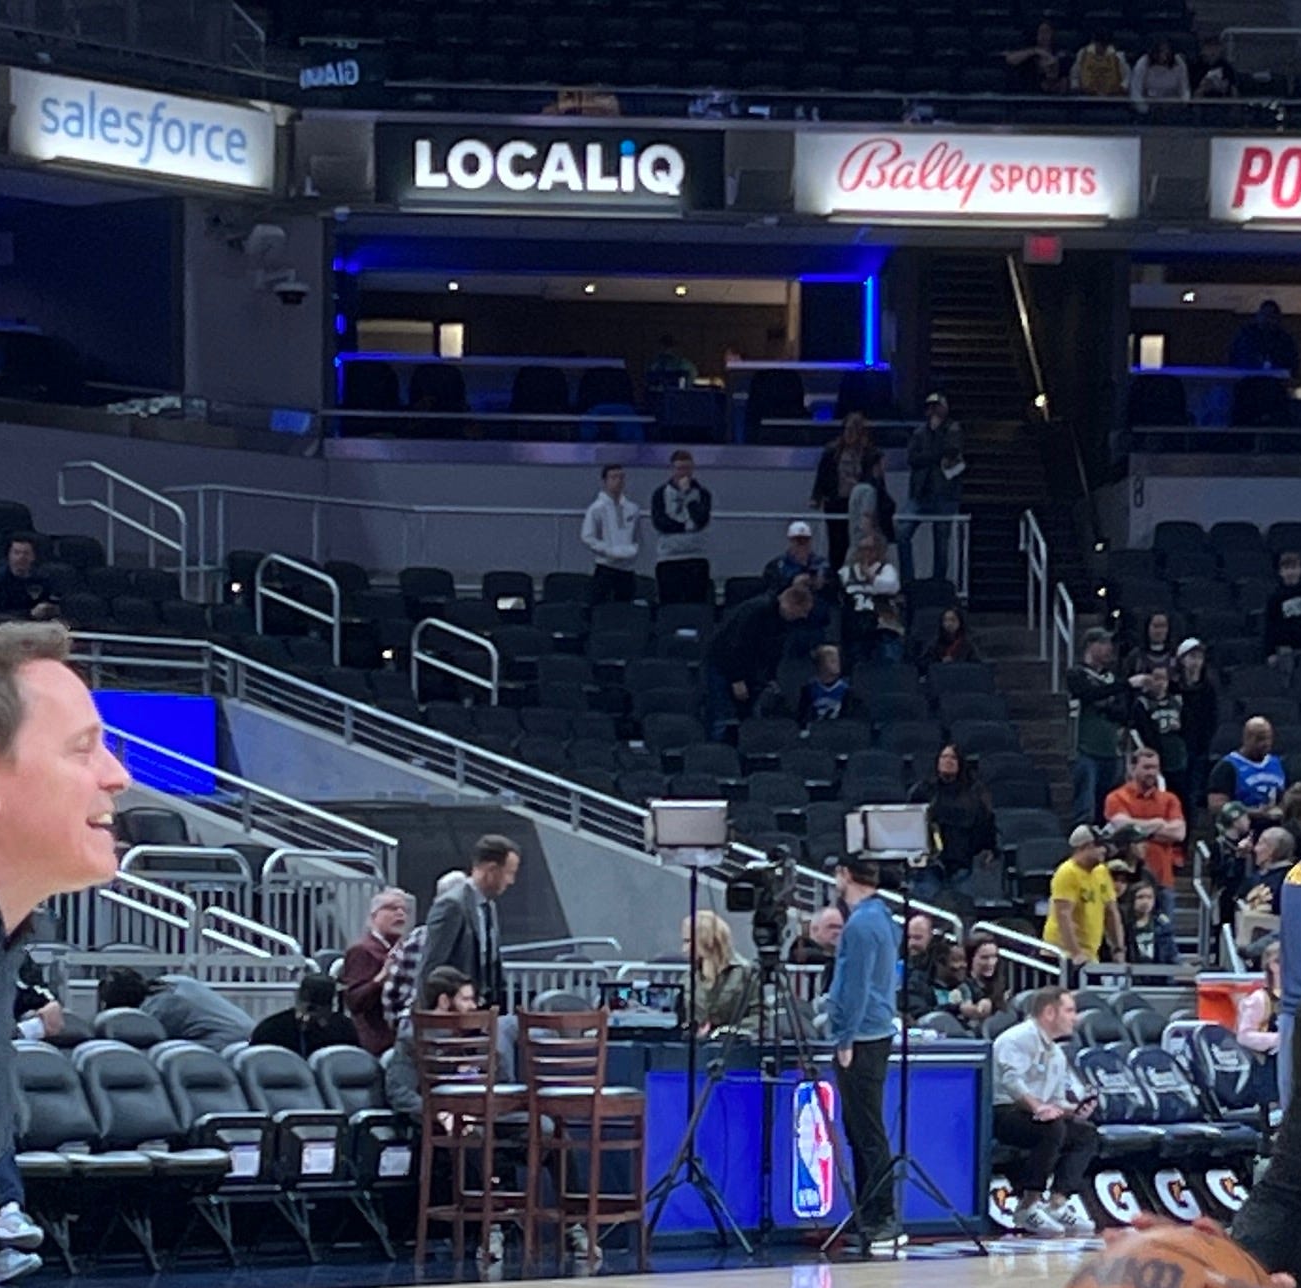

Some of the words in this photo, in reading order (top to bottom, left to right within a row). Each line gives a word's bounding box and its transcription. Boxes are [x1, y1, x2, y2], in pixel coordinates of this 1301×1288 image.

[40, 90, 247, 164] salesforce
[837, 137, 985, 209] Bally
[989, 164, 1096, 196] SPORTS
